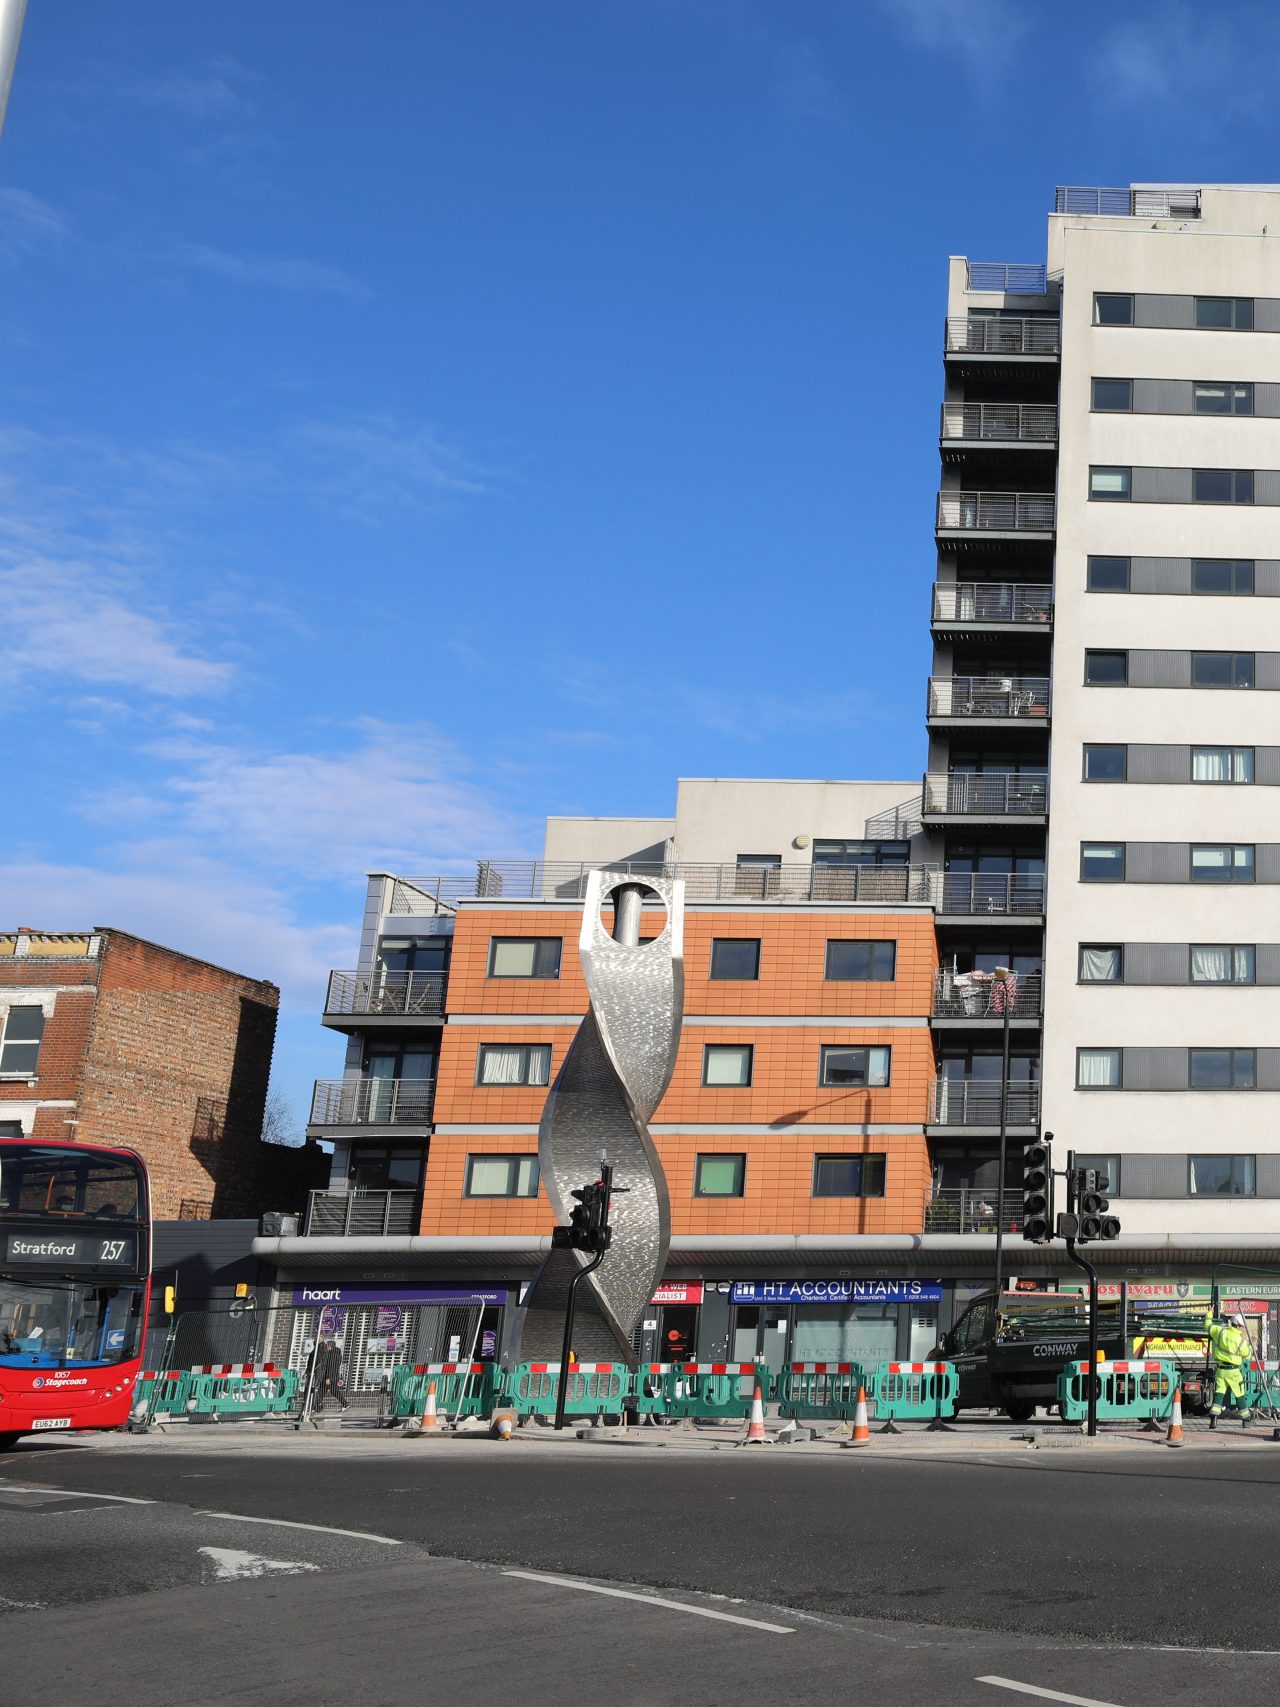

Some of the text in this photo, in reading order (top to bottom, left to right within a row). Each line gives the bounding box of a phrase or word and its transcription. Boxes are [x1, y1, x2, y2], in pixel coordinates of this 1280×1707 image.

[12, 1240, 126, 1260] Stratford 257
[302, 1286, 341, 1301] haart
[763, 1281, 922, 1296] HT ACCOUNTANTS
[1087, 1284, 1174, 1295] ostavaru
[1226, 1286, 1262, 1294] EASTERN
[1033, 1343, 1079, 1357] CONWAY
[54, 1371, 71, 1379] 10157
[44, 1378, 88, 1388] Stagecoach
[35, 1420, 53, 1428] EU62
